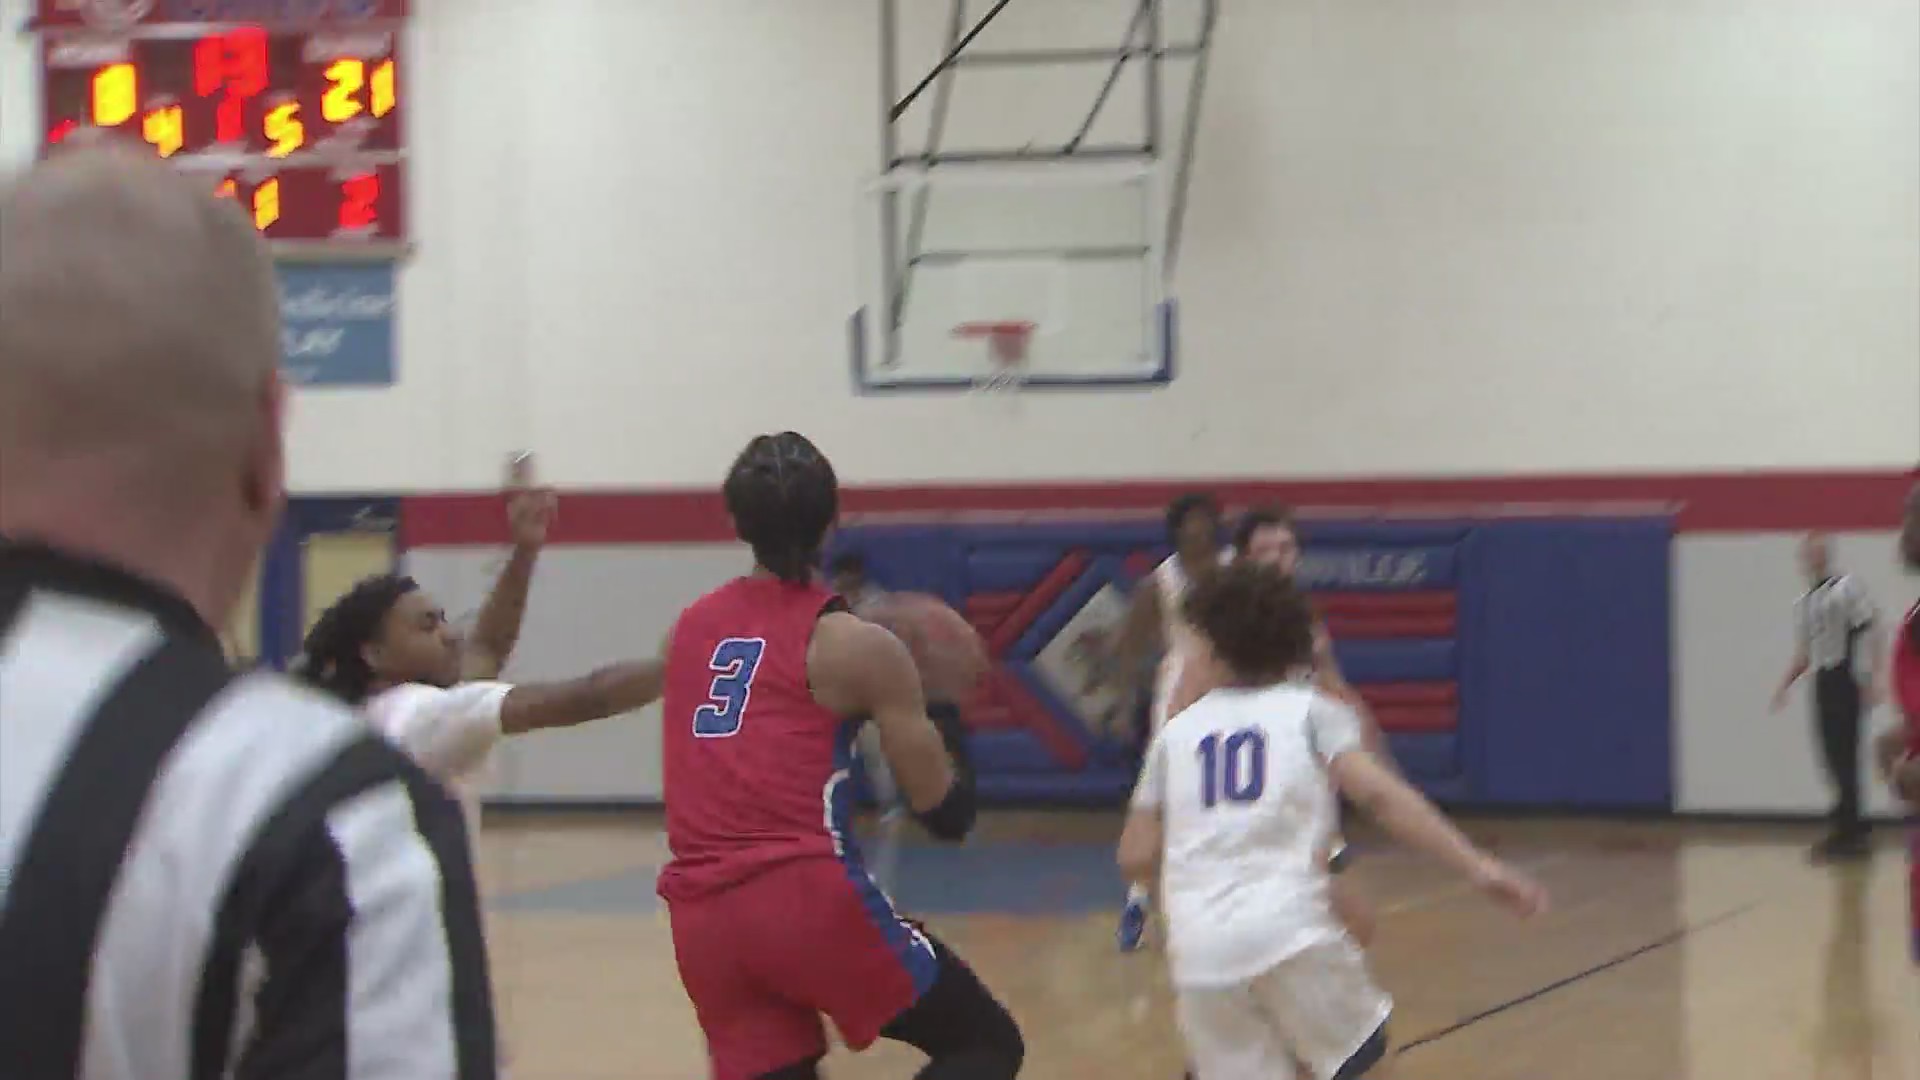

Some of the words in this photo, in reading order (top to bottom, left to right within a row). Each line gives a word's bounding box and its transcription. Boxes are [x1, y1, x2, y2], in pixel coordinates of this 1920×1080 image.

[320, 57, 395, 122] 21
[264, 103, 304, 158] 5
[692, 637, 766, 738] 3
[1195, 729, 1268, 810] 10
